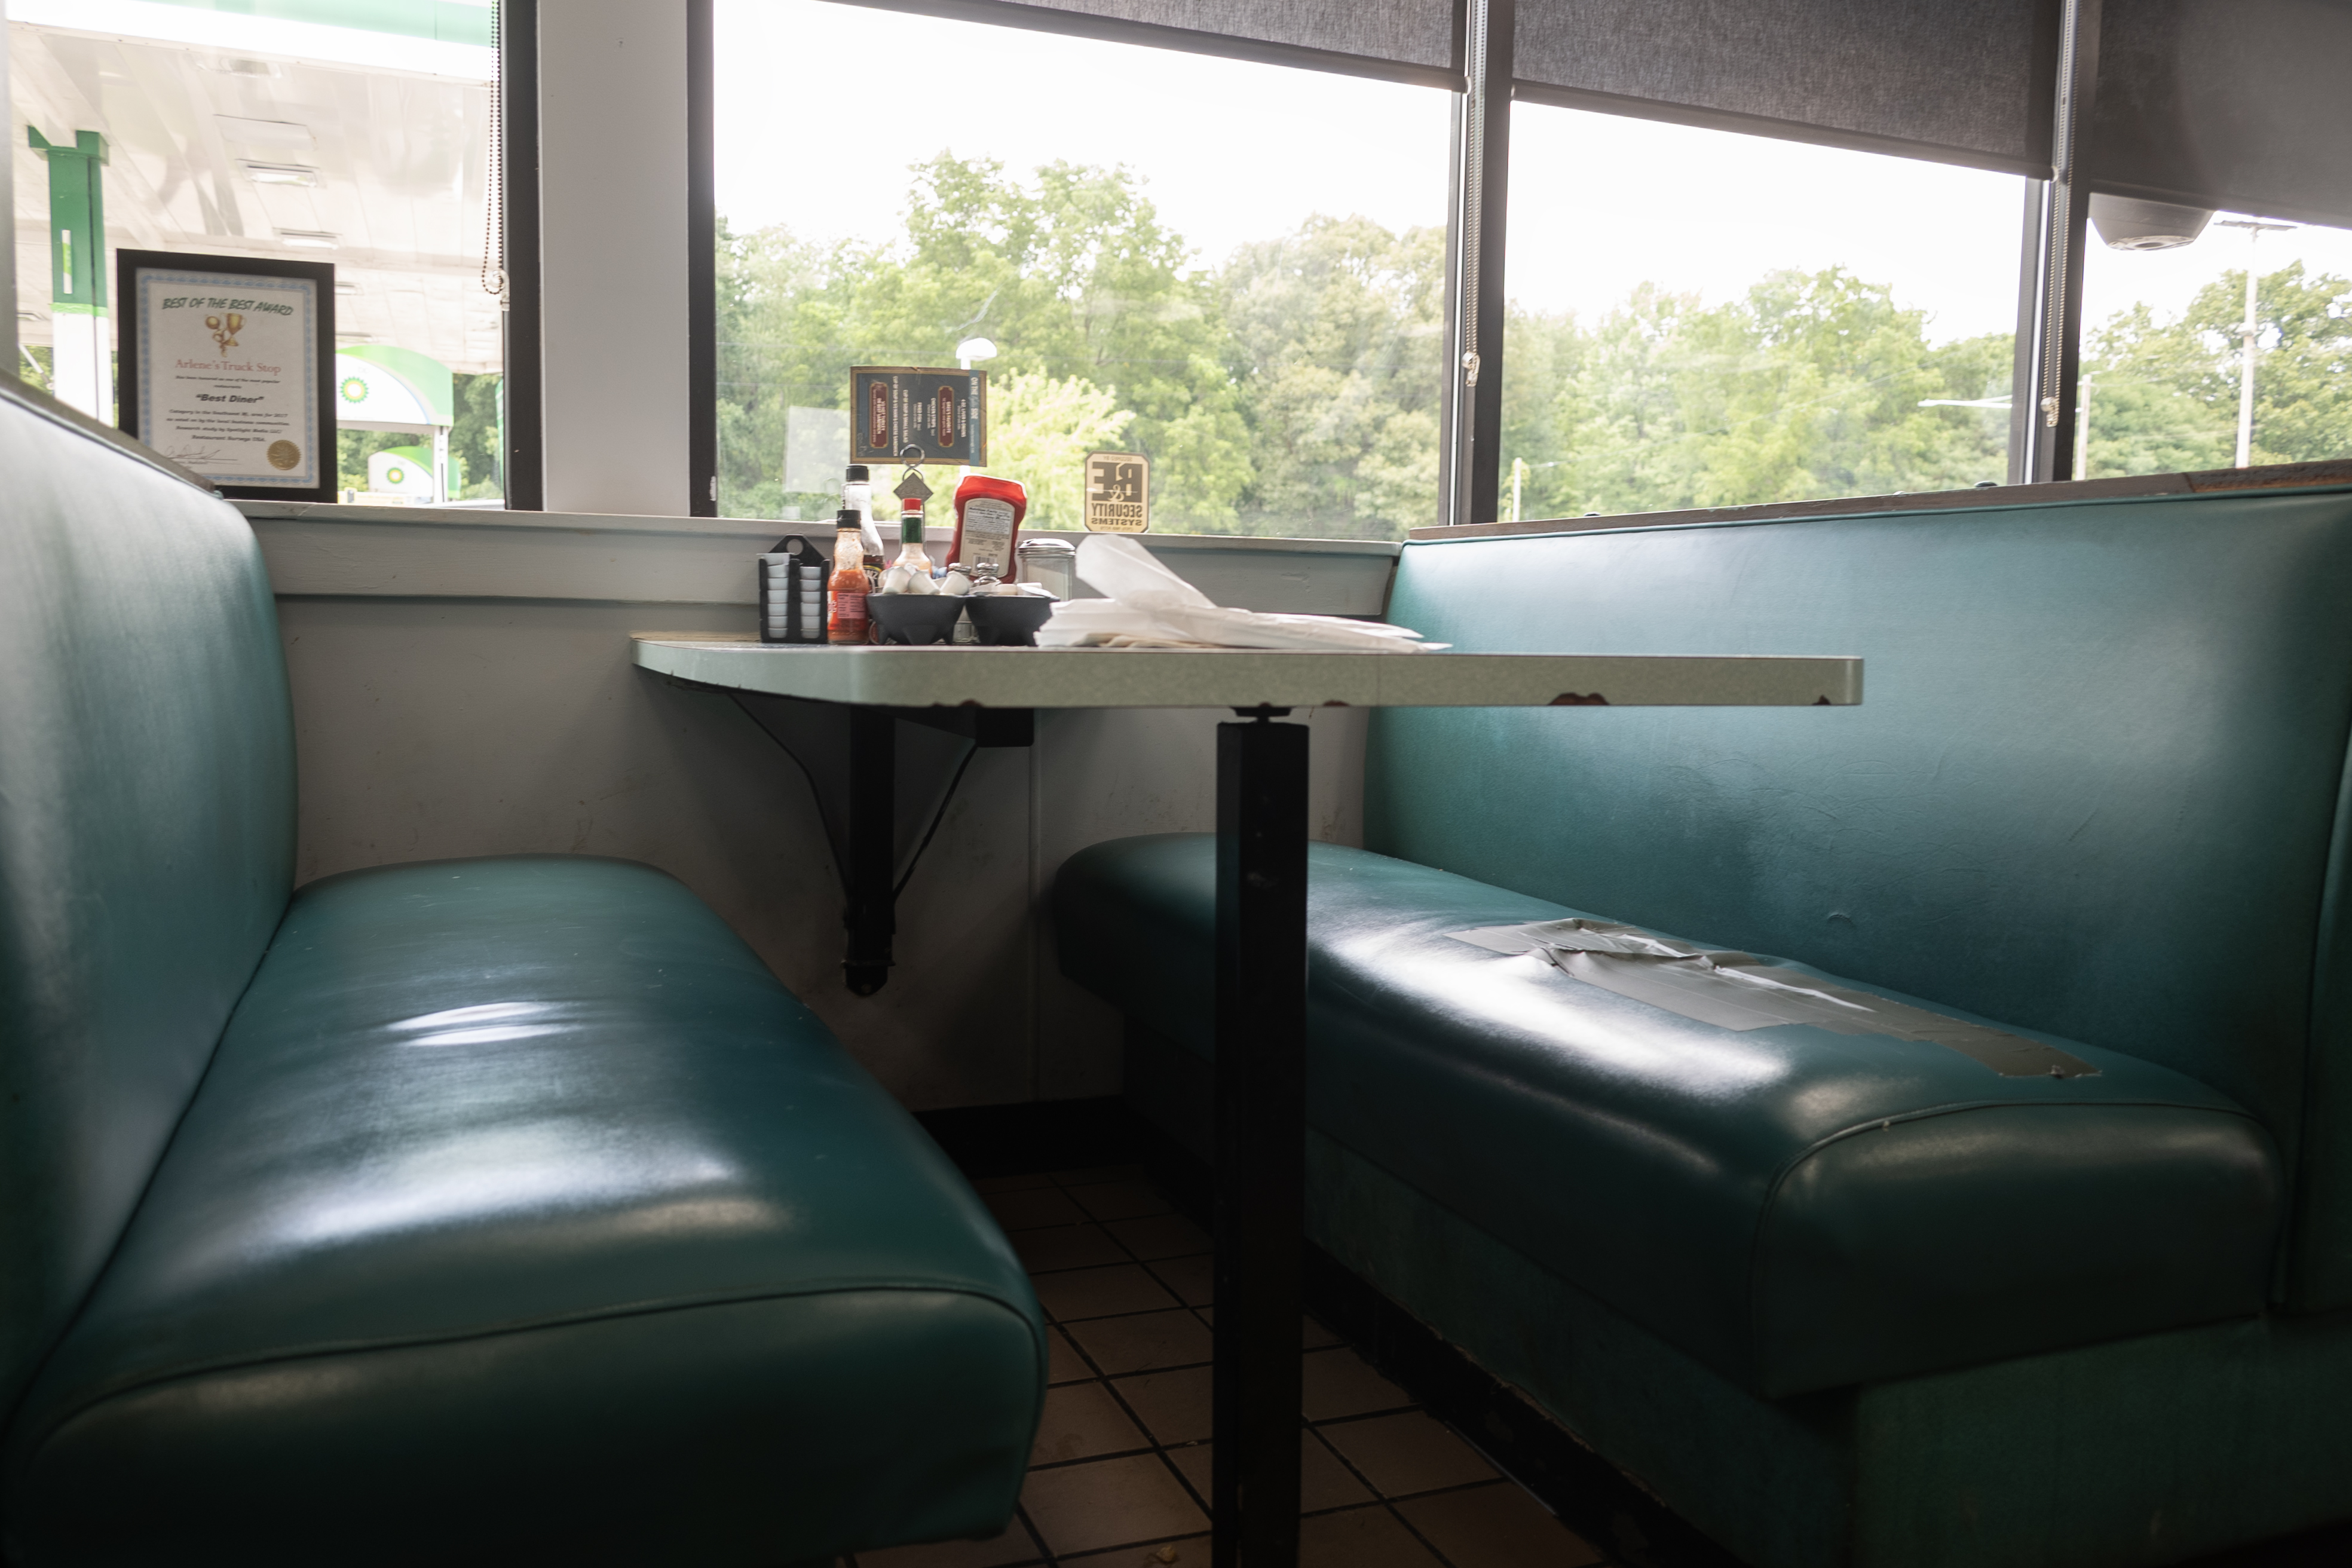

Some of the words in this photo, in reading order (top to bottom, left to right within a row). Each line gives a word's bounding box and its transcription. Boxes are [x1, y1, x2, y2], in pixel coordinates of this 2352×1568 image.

[162, 298, 189, 310] BEST
[189, 298, 206, 308] OF
[207, 298, 228, 309] THE
[228, 299, 256, 310] BEST
[253, 302, 293, 316] AWARD
[175, 359, 220, 370] Arlene's
[221, 361, 253, 372] Truck
[256, 363, 281, 376] Stop
